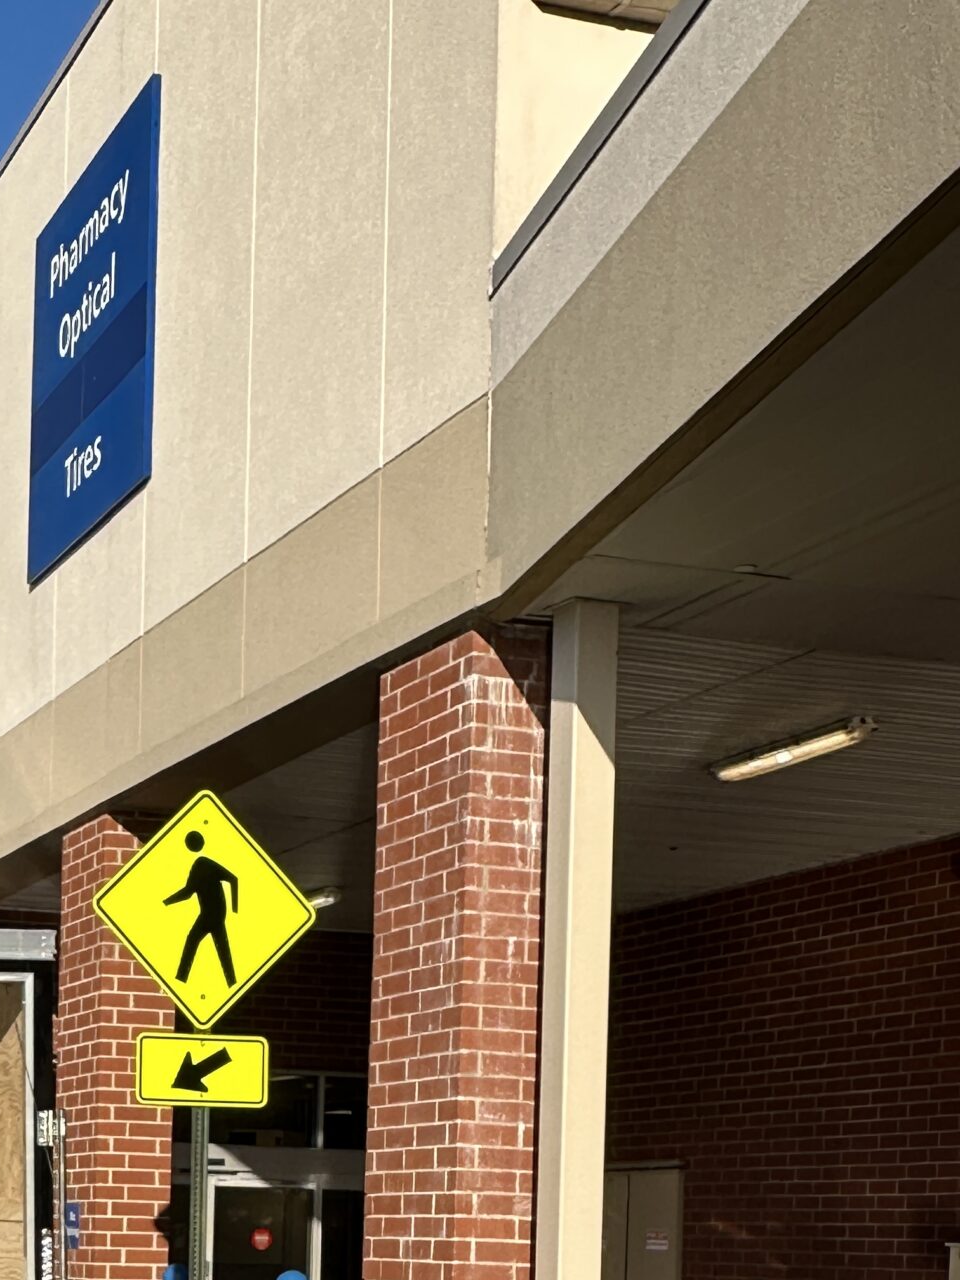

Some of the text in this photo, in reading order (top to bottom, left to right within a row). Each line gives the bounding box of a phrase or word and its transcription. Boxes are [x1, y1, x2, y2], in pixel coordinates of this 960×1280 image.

[50, 169, 129, 299] Pharmacy
[59, 251, 116, 358] Optical
[65, 435, 102, 498] Tires
